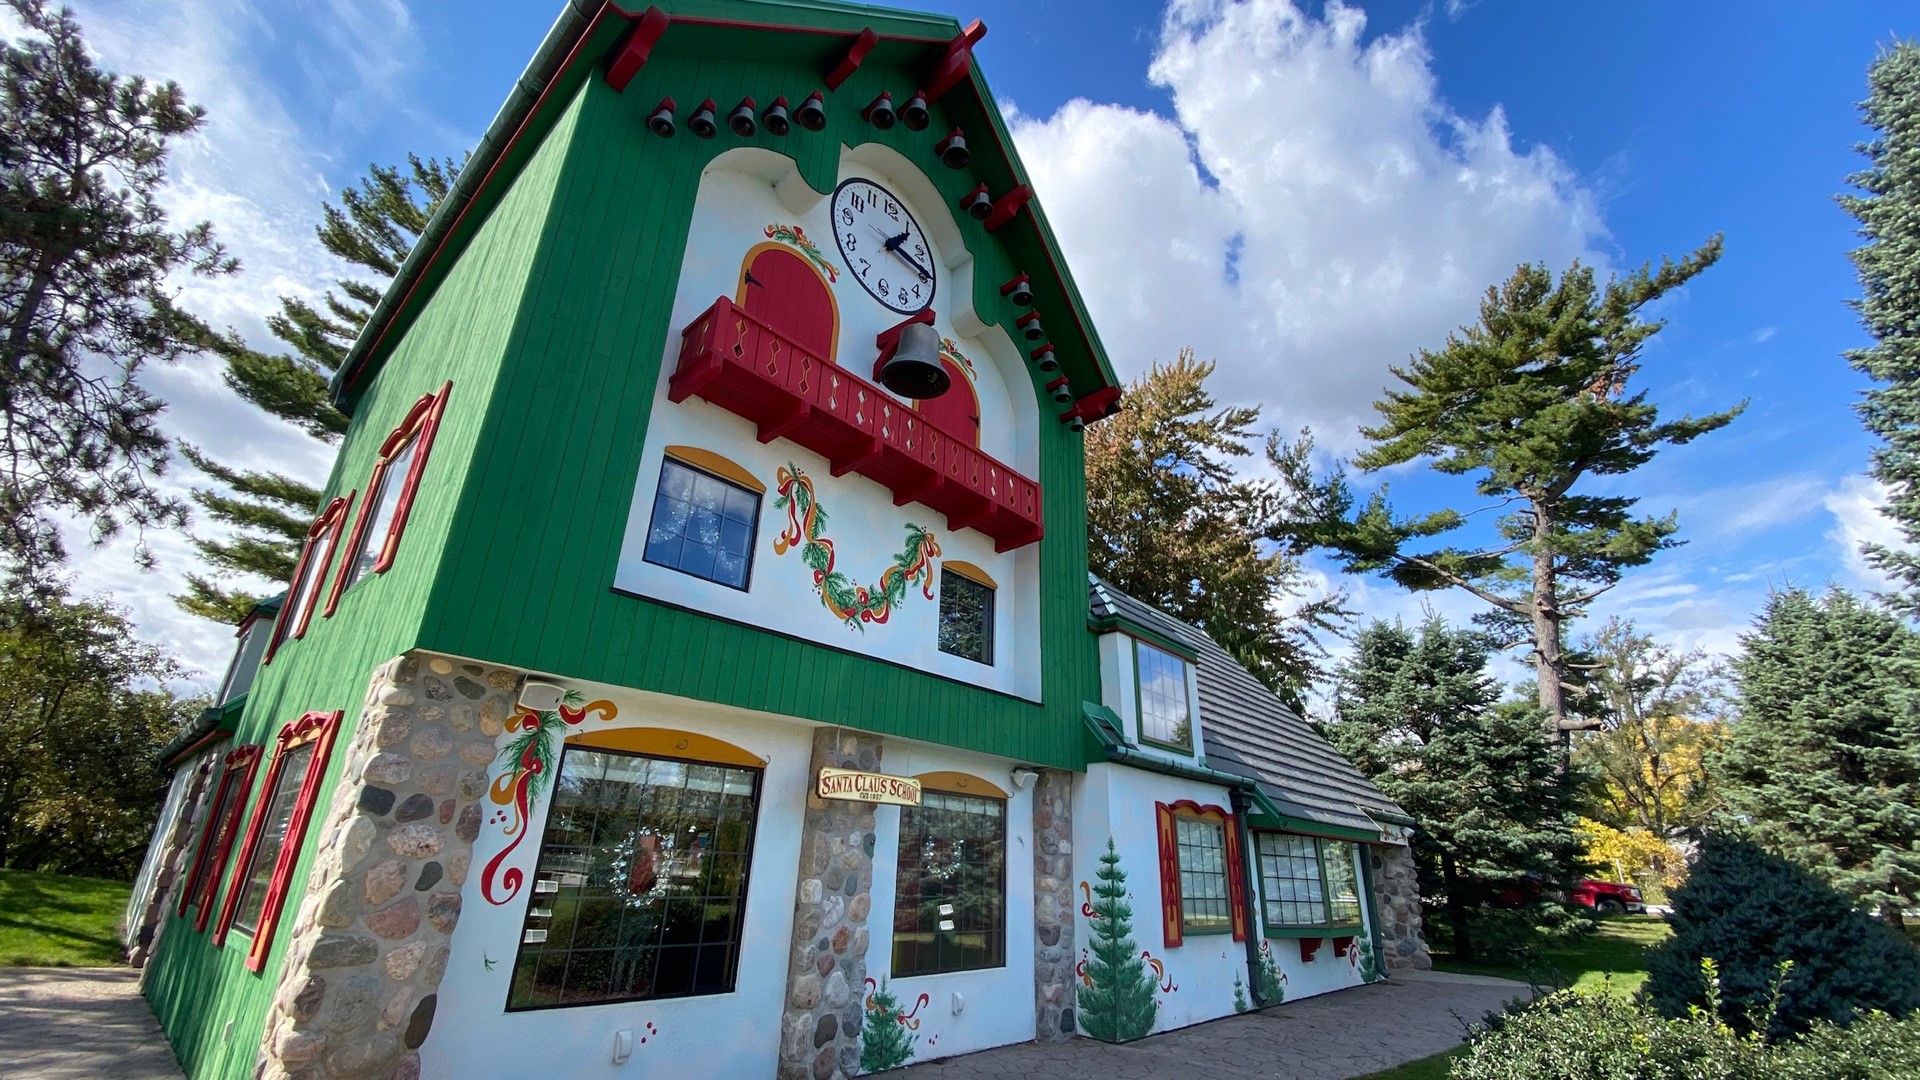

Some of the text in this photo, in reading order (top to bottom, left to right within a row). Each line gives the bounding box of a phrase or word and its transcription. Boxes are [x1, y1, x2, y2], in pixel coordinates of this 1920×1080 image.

[851, 191, 865, 213] 10
[867, 189, 877, 208] 11
[842, 207, 854, 226] 9
[884, 199, 899, 222] 12
[846, 233, 857, 252] 8
[915, 244, 925, 263] 2
[859, 257, 872, 277] 7
[877, 278, 890, 297] 6
[898, 287, 909, 305] 5
[911, 284, 921, 299] 4
[822, 774, 919, 804] SANTA CLAUS SCHOOL
